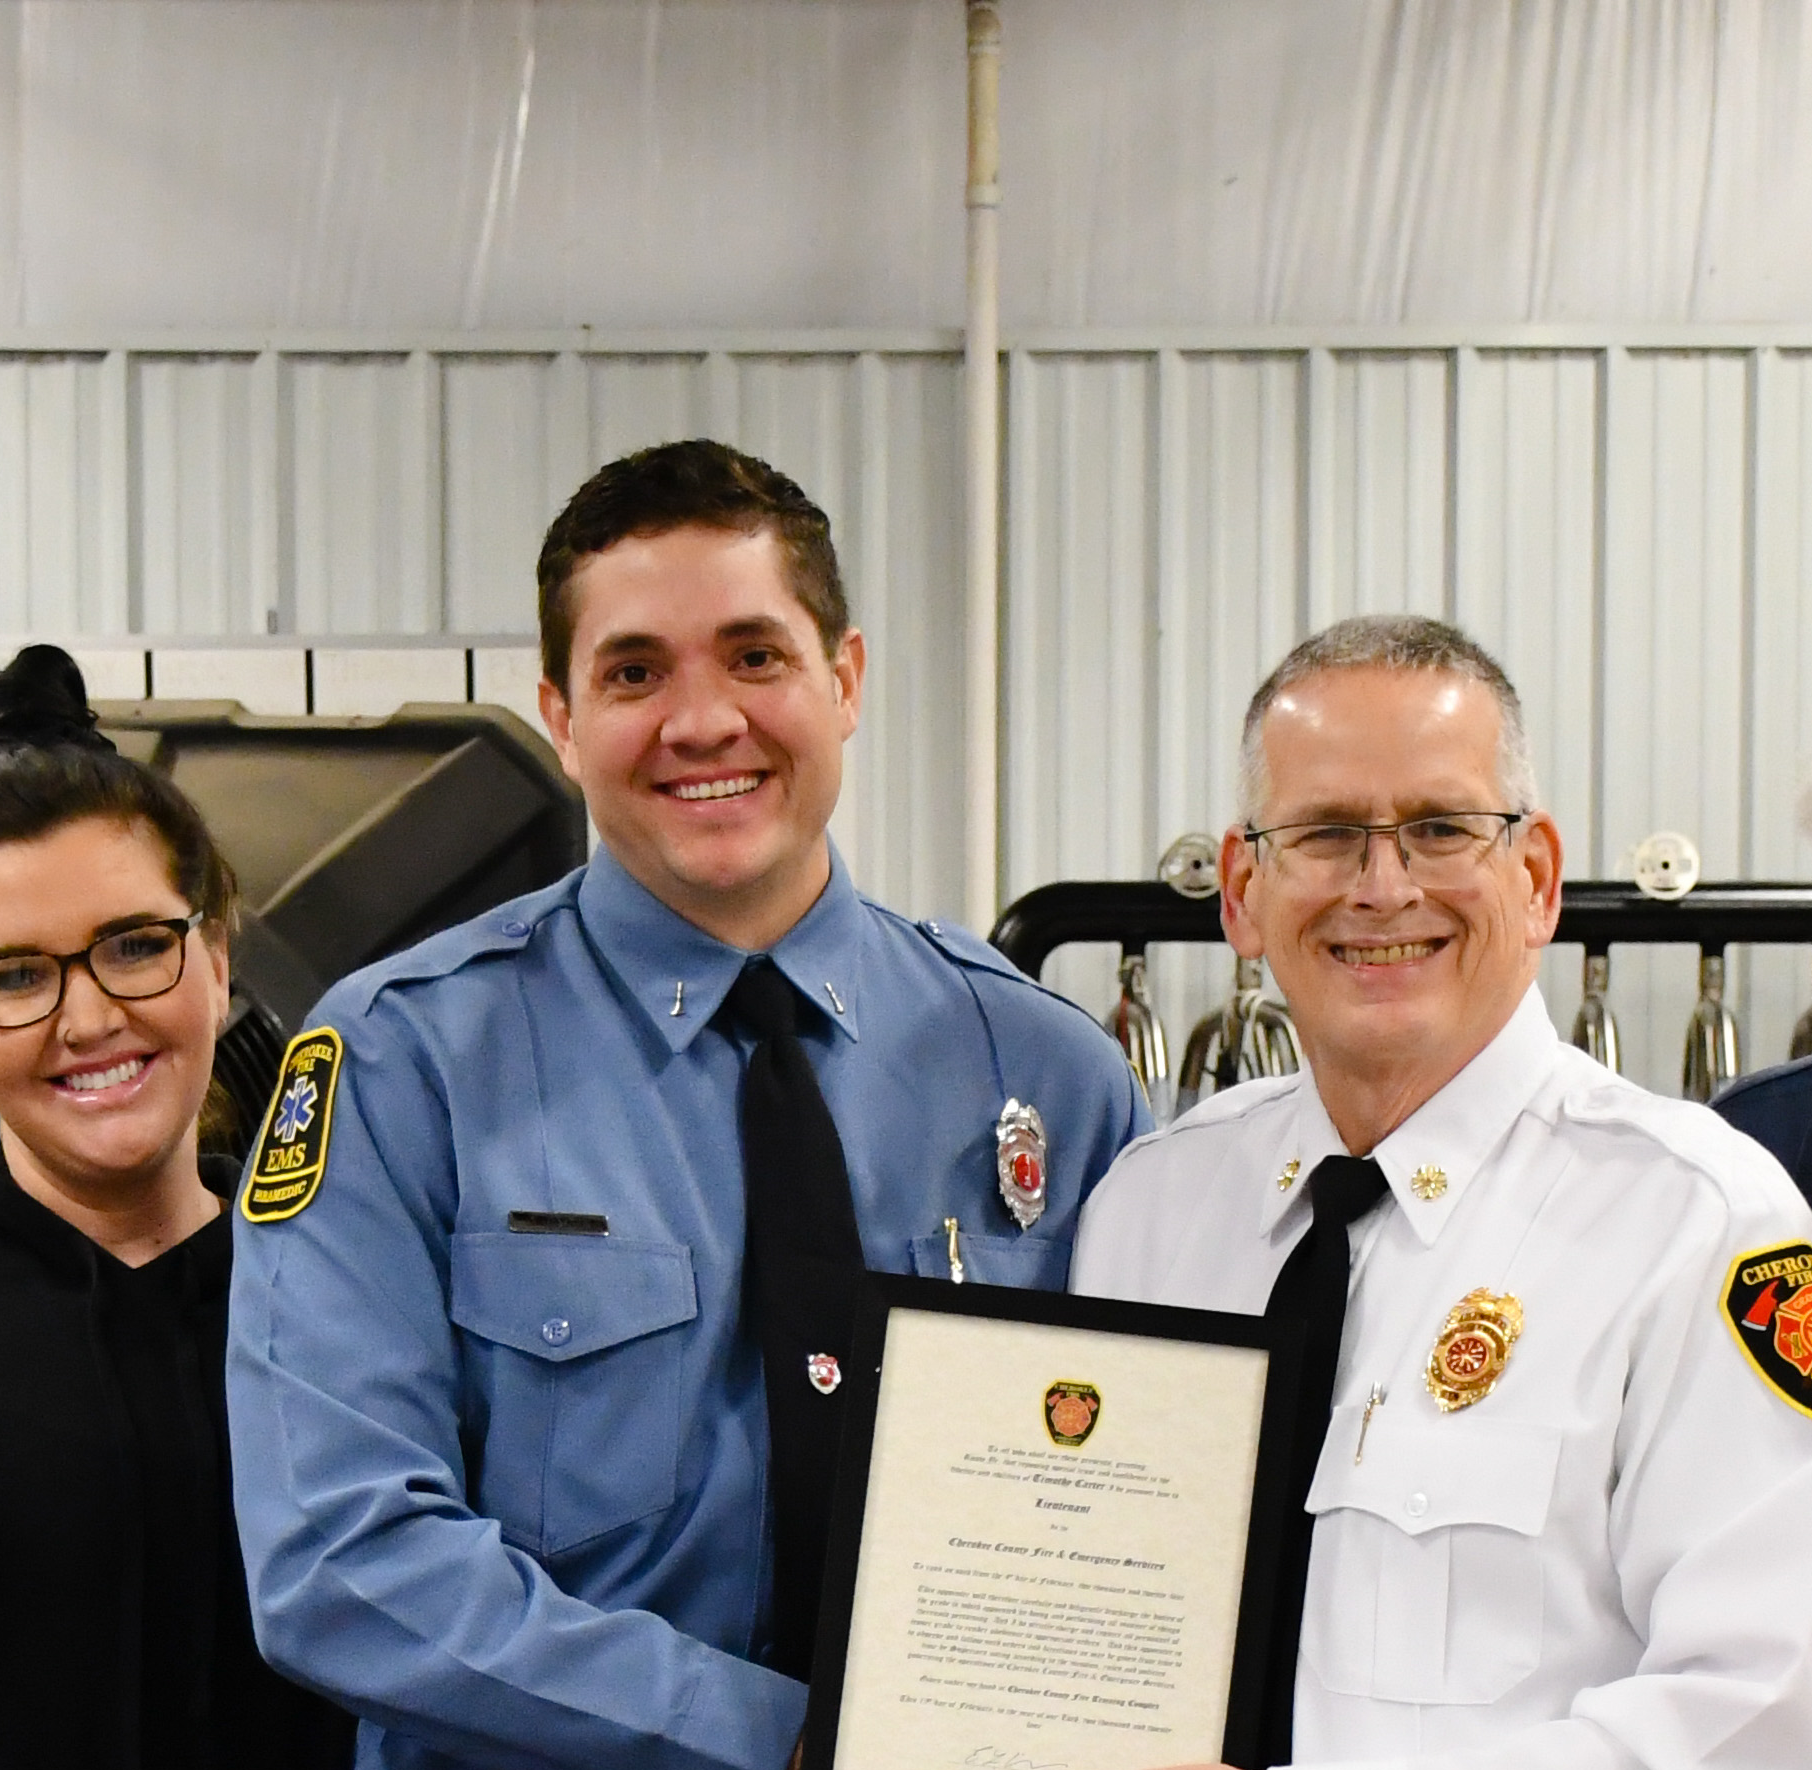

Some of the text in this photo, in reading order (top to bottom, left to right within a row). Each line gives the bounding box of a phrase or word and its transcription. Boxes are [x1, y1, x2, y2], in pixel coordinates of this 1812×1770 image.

[295, 1058, 315, 1077] FIRE
[264, 1143, 307, 1172] EMS
[252, 1181, 308, 1203] PARAMEDIC
[1032, 1473, 1072, 1487] Timothy
[1074, 1478, 1106, 1490] Carter
[1034, 1497, 1091, 1514] Lieutenant
[947, 1537, 1166, 1571] Cherokee County Fire & Emergency Services
